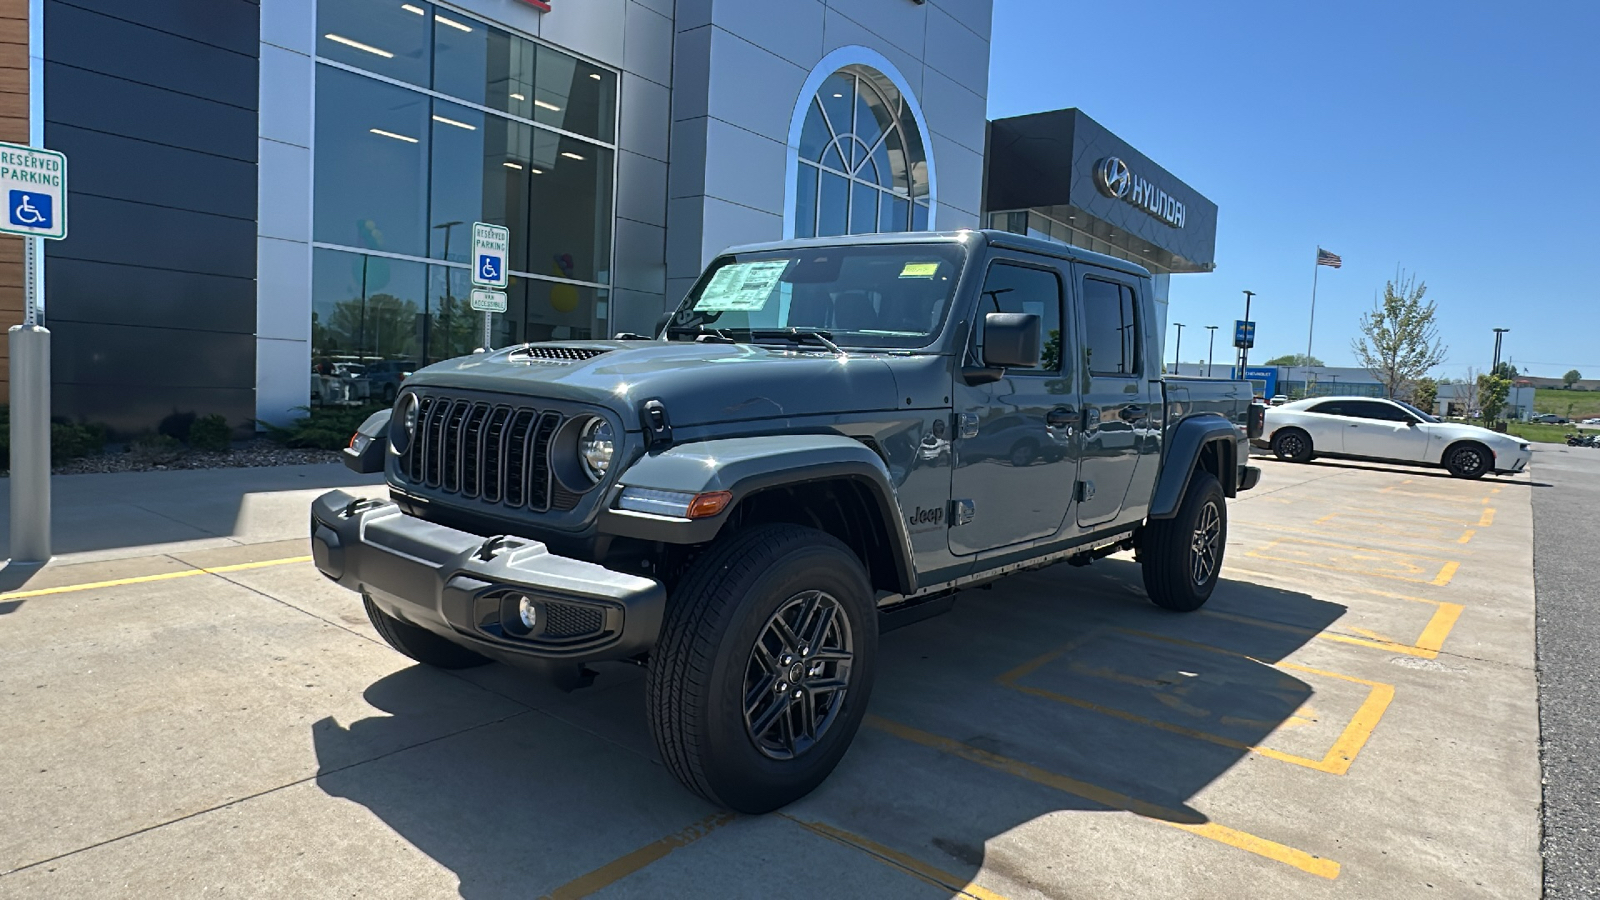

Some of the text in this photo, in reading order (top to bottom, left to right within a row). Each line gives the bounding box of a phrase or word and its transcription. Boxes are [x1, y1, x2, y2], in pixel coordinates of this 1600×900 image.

[2, 152, 59, 172] RESERVED
[2, 167, 59, 187] PARKING
[1132, 174, 1186, 229] HYUNDAI
[477, 229, 505, 241] RESERVED
[476, 240, 505, 251] PARKING
[910, 506, 943, 525] Jeep
